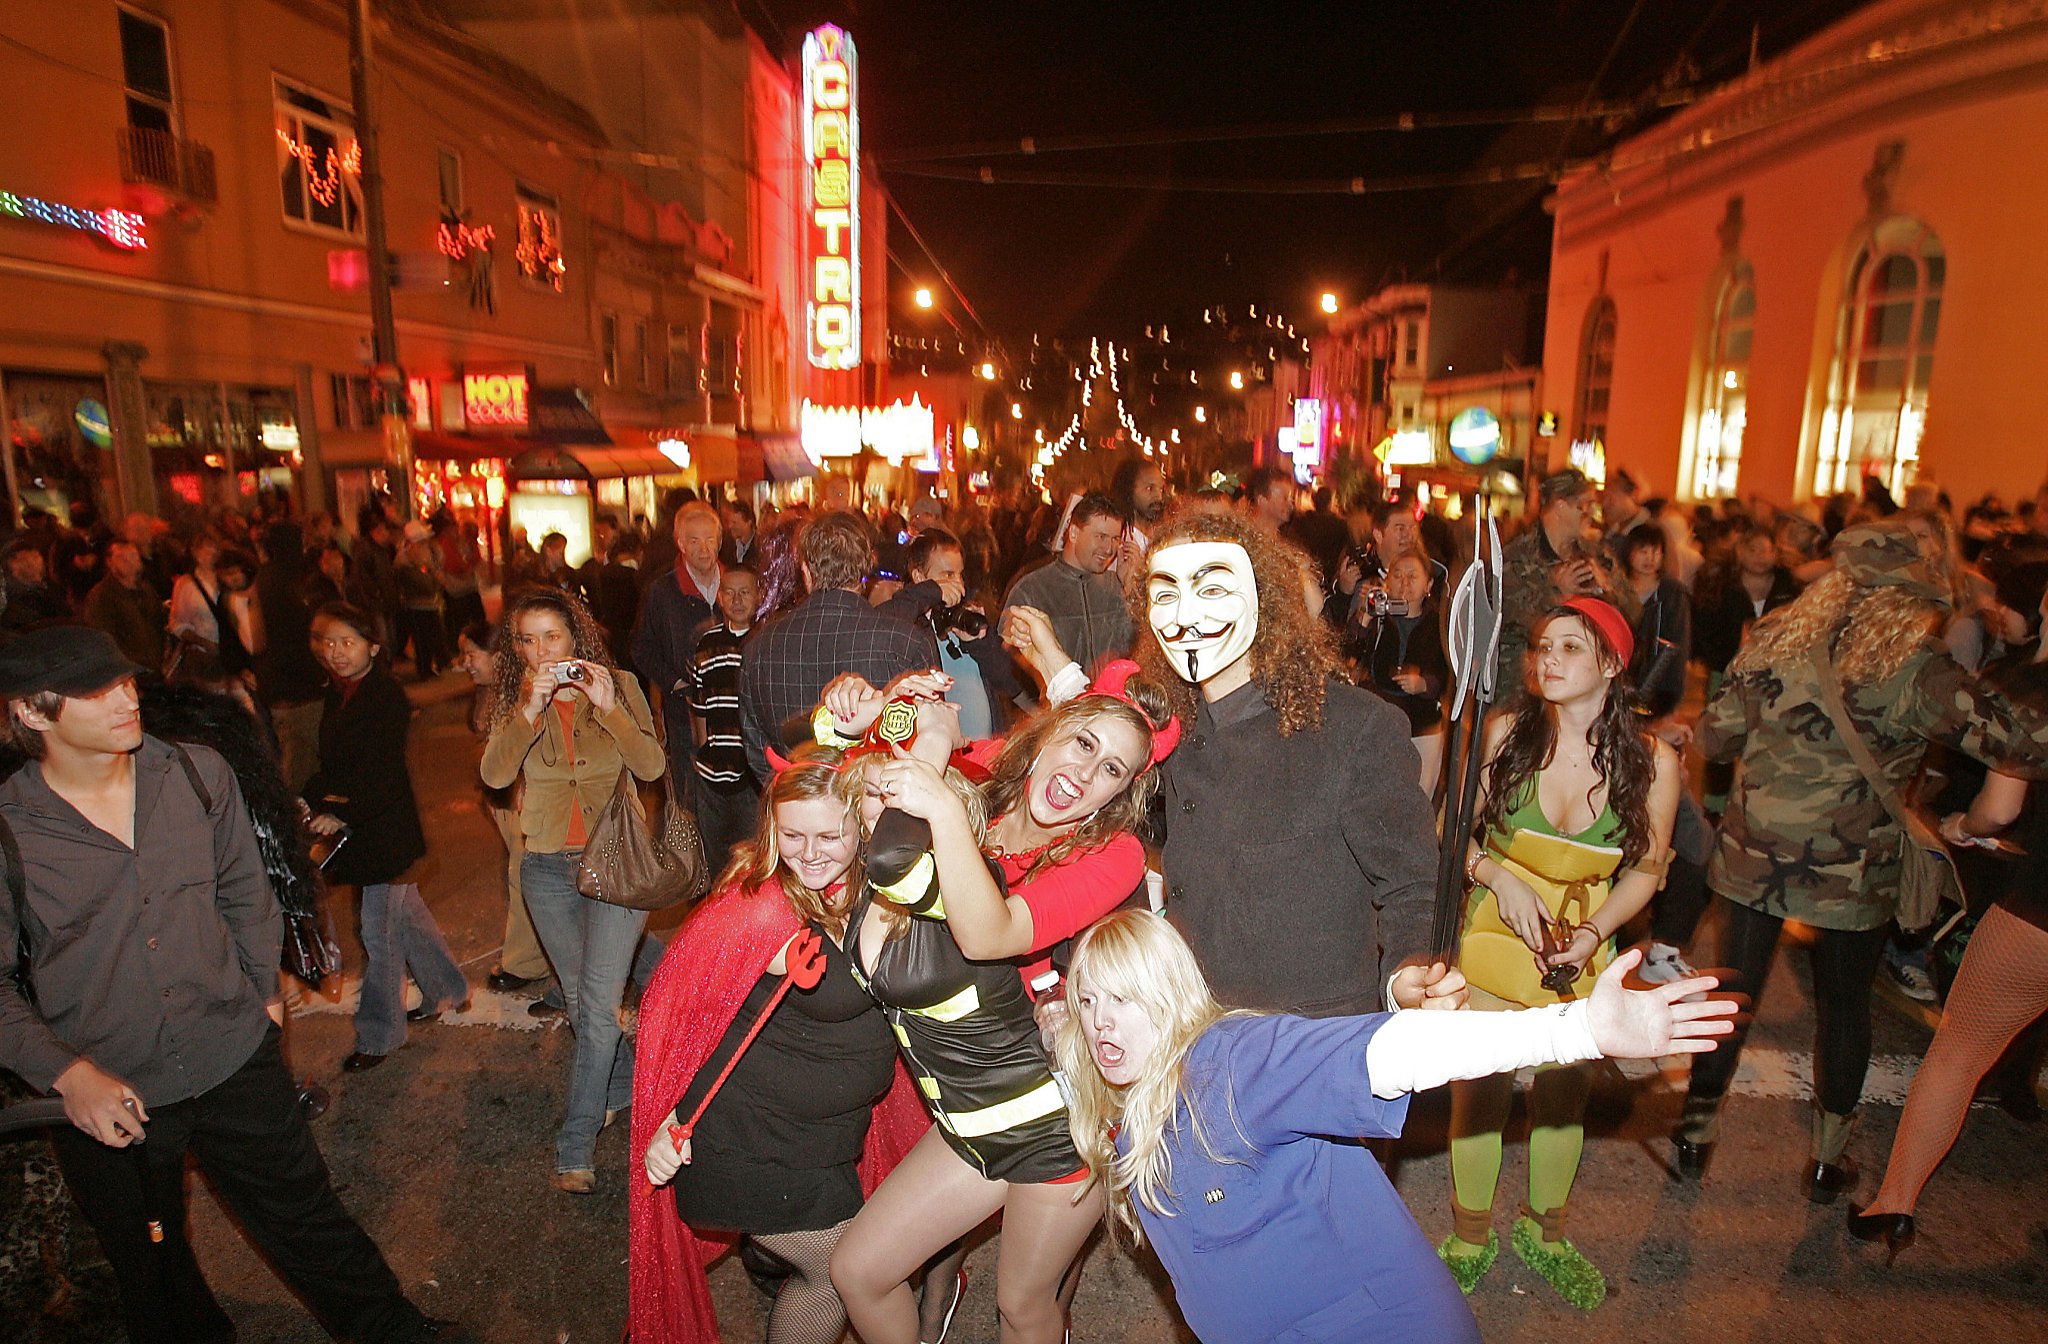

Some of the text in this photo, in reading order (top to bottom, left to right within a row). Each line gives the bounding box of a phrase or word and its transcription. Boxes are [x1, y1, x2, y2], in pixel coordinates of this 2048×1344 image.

[813, 61, 850, 347] CASTRO
[465, 374, 527, 405] HOT
[466, 403, 528, 424] COOKIE
